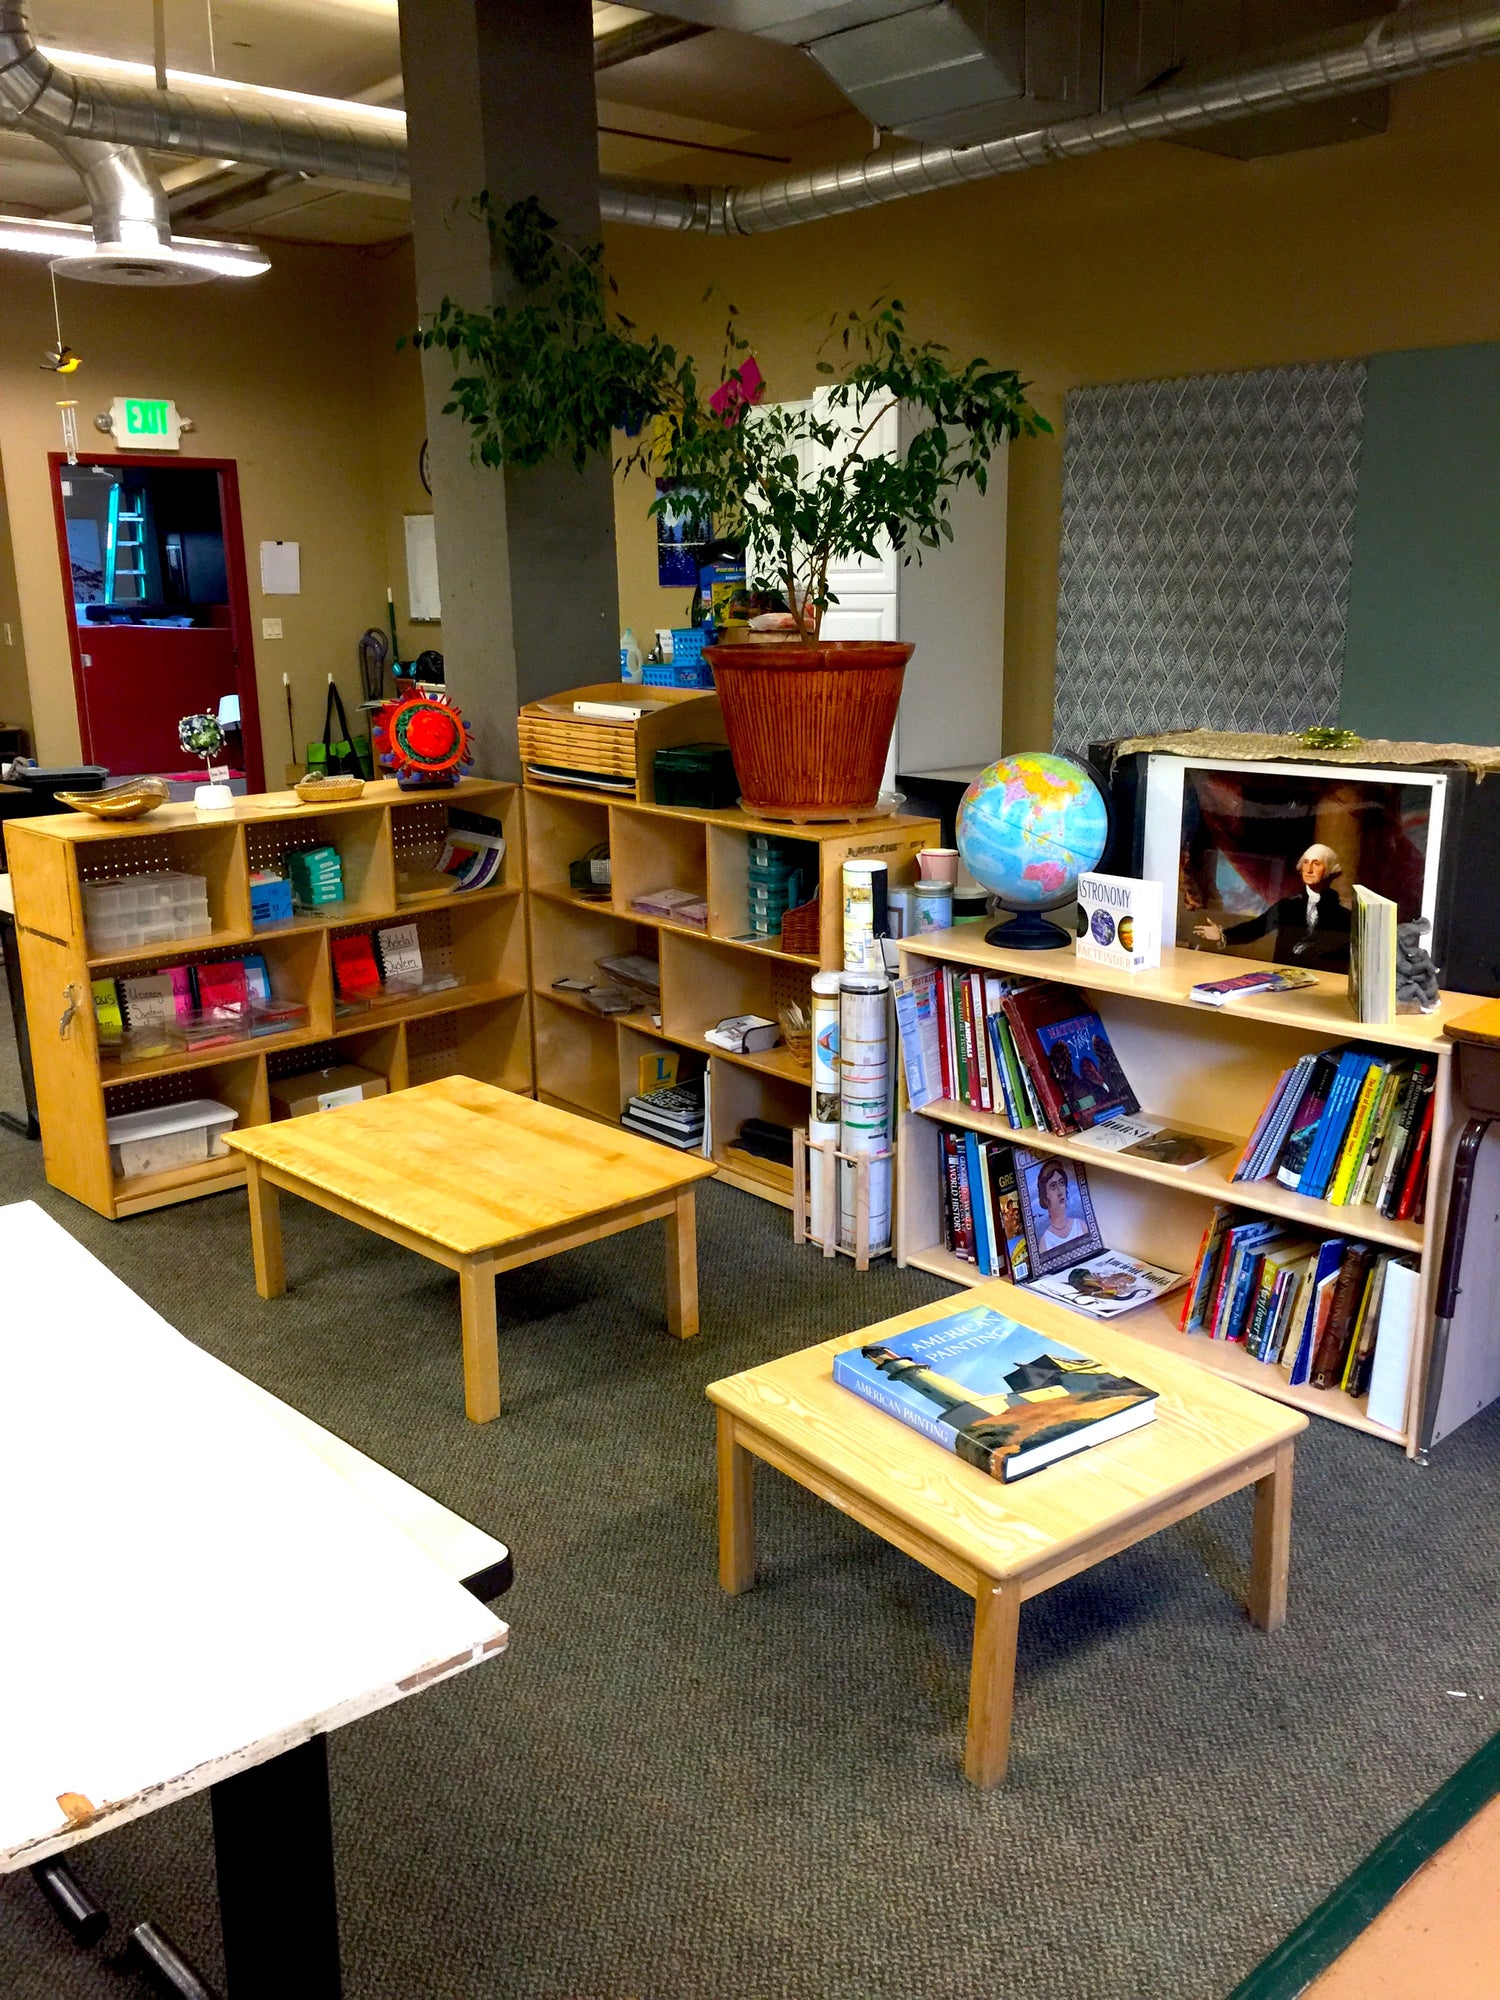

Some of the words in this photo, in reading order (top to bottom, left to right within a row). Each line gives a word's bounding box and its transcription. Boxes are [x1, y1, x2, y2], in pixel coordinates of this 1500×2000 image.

[126, 400, 168, 434] EXIT
[381, 930, 413, 950] Skeletal
[386, 953, 418, 973] System
[964, 1021, 973, 1058] ANIMALS
[656, 1058, 672, 1080] L
[949, 1165, 959, 1197] WORLD
[998, 1172, 1016, 1188] GRE
[951, 1196, 962, 1233] HISTORY
[1141, 1271, 1171, 1286] India
[1252, 1283, 1272, 1335] Mayflower
[911, 1316, 1001, 1352] AMERICAN
[925, 1327, 1009, 1362] PAINTING
[855, 1379, 901, 1416] AMERICAN
[903, 1407, 948, 1443] PAINTING
